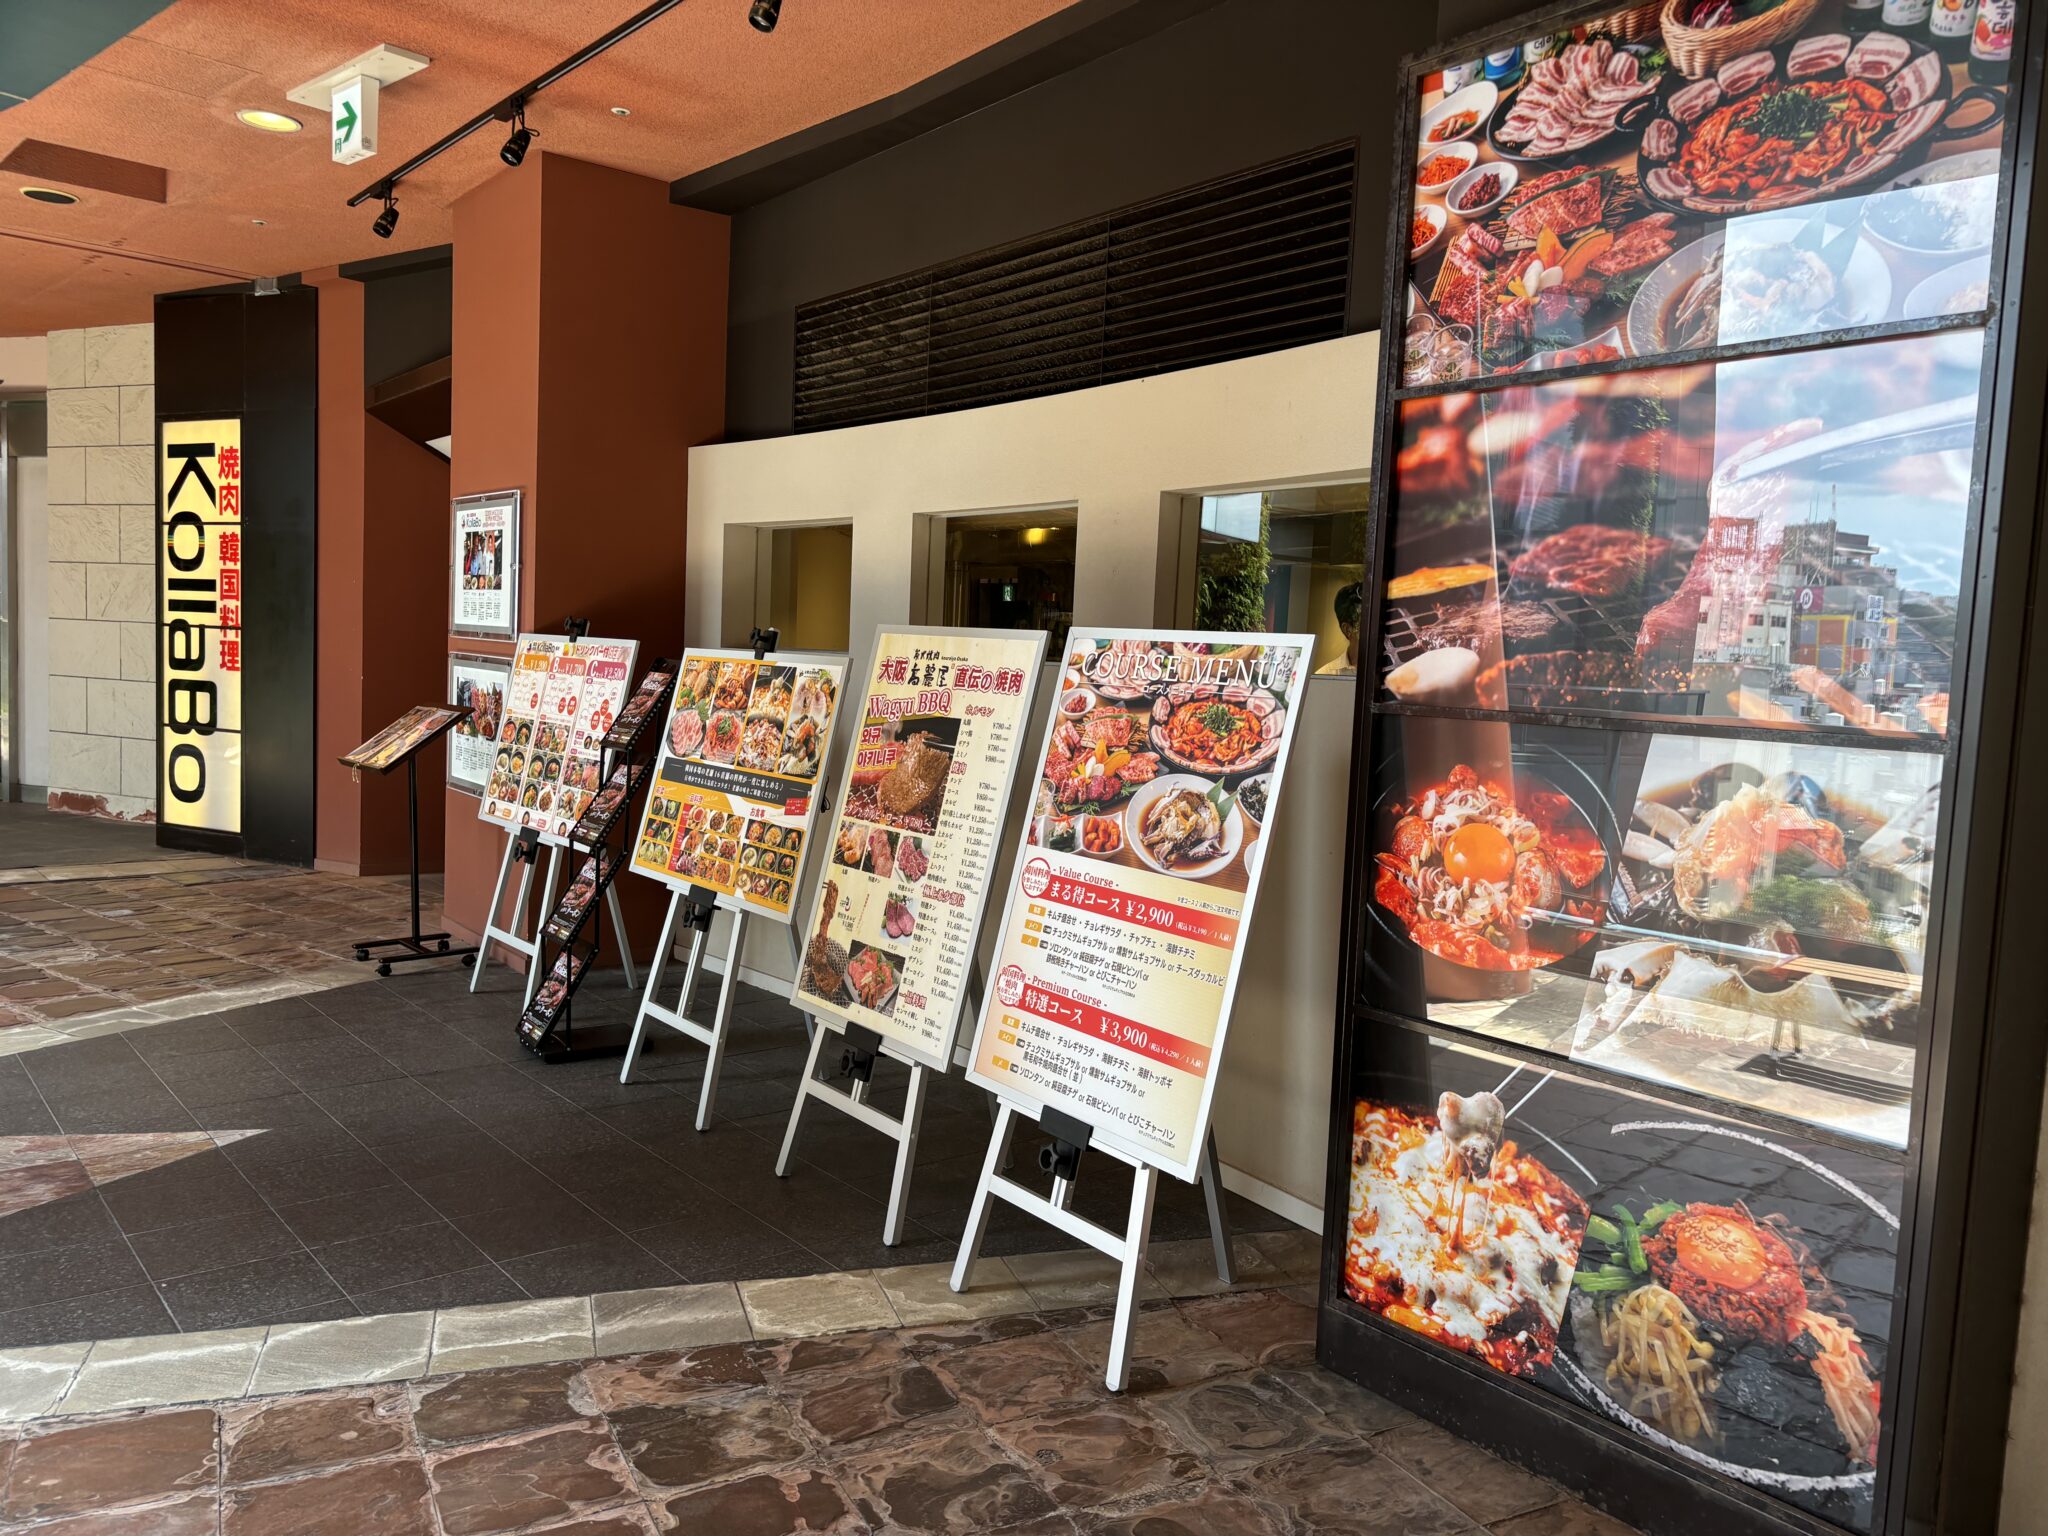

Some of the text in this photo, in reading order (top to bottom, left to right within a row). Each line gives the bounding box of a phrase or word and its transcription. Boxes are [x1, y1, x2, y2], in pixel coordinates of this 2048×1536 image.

[218, 446, 240, 672] 焼肉 韓国料理
[167, 443, 217, 803] KollaBo
[878, 658, 908, 683] 大阪
[954, 666, 1024, 694] 直伝の焼肉
[1081, 651, 1280, 689] COURSE MENU
[870, 692, 951, 720] Wagyu BBQ
[1059, 866, 1114, 887] Value Course
[1050, 881, 1120, 912] まる得コース
[1025, 988, 1083, 1025] 特選コース
[1032, 975, 1069, 997] Premium
[1071, 989, 1102, 1008] Course
